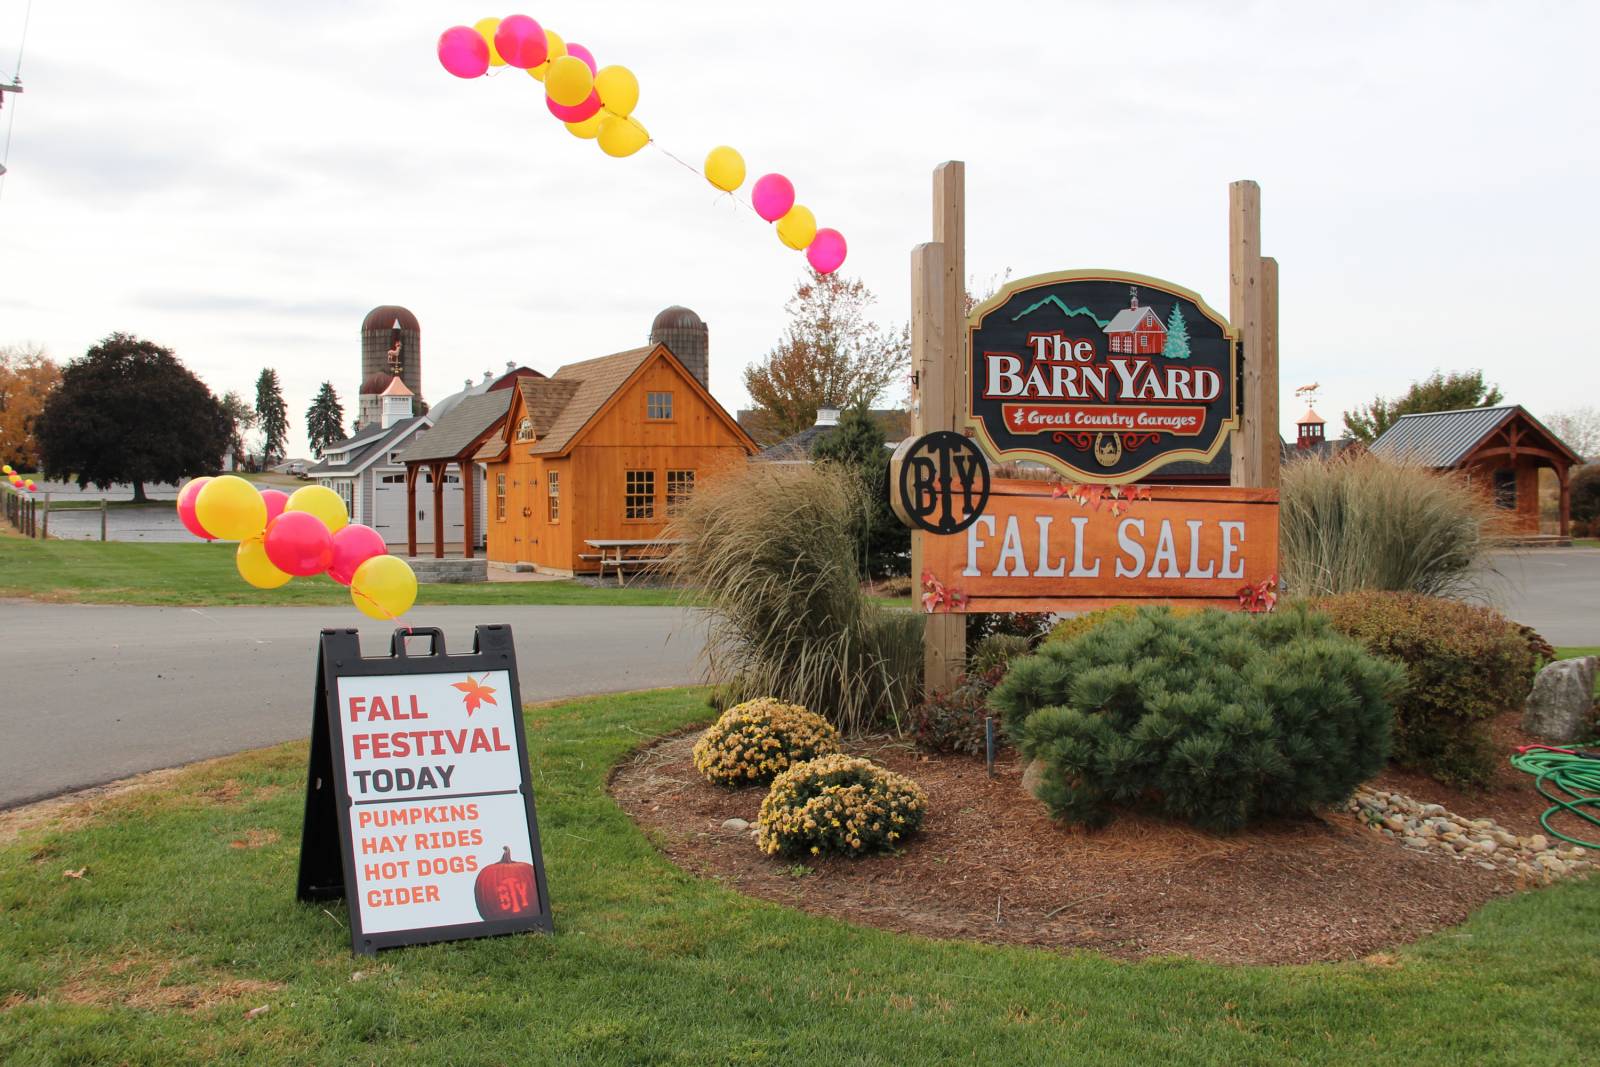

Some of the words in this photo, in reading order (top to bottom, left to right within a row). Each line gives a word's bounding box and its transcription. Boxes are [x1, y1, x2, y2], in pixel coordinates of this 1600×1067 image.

[1030, 335, 1093, 362] The
[1028, 410, 1071, 425] Great
[1074, 411, 1134, 428] Country
[1137, 412, 1196, 429] Garages
[910, 437, 978, 527] BTY
[962, 514, 1100, 577] FALL
[1115, 518, 1245, 579] SALE
[349, 694, 428, 722] FALL
[352, 727, 511, 760] FESTIVAL
[353, 764, 455, 794] TODAY
[358, 803, 479, 829] PUMPKINS
[361, 835, 408, 854] HAY
[414, 828, 483, 850] RIDES
[364, 860, 410, 881] HOT
[417, 855, 478, 876] DOGS
[367, 885, 440, 908] CIDER
